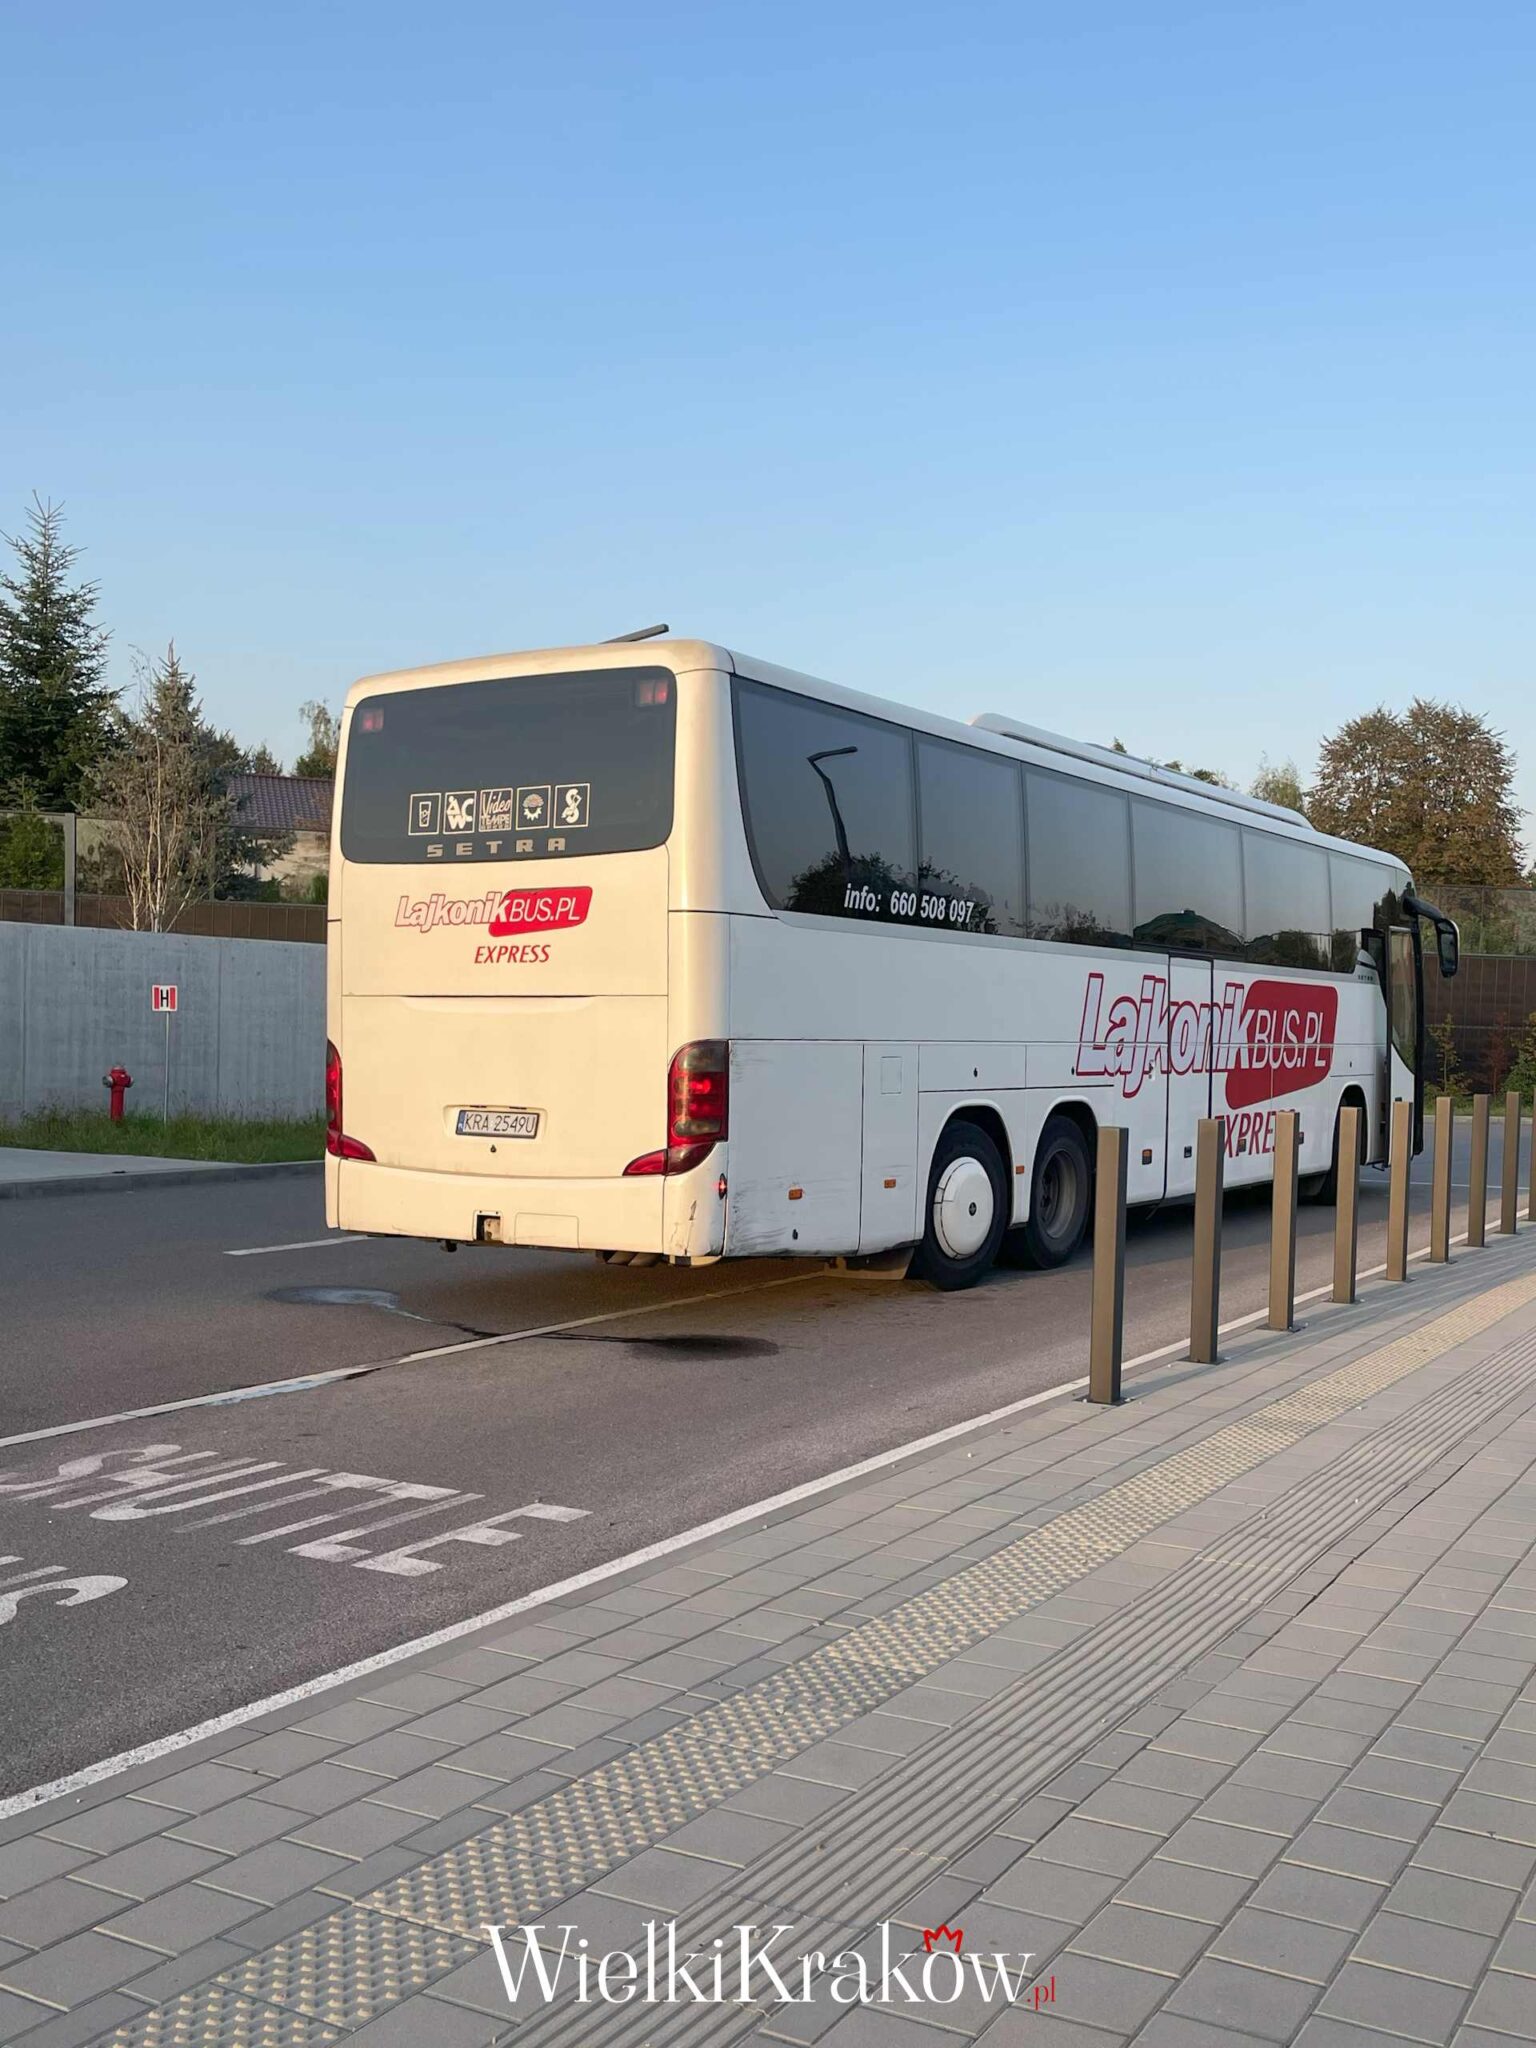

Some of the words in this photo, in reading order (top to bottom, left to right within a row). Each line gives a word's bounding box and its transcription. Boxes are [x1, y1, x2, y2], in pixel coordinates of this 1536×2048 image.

[482, 789, 512, 816] Video
[426, 837, 566, 858] SETRA
[843, 883, 882, 912] info:
[890, 890, 917, 917] 660
[920, 895, 946, 920] 508
[949, 899, 975, 923] 097
[474, 944, 551, 964] EXPRESS
[160, 988, 169, 1008] H
[464, 1113, 490, 1132] KRA
[493, 1115, 536, 1134] 2549U
[1214, 1108, 1297, 1158] XPRE
[0, 1444, 594, 1577] SHUTTLE
